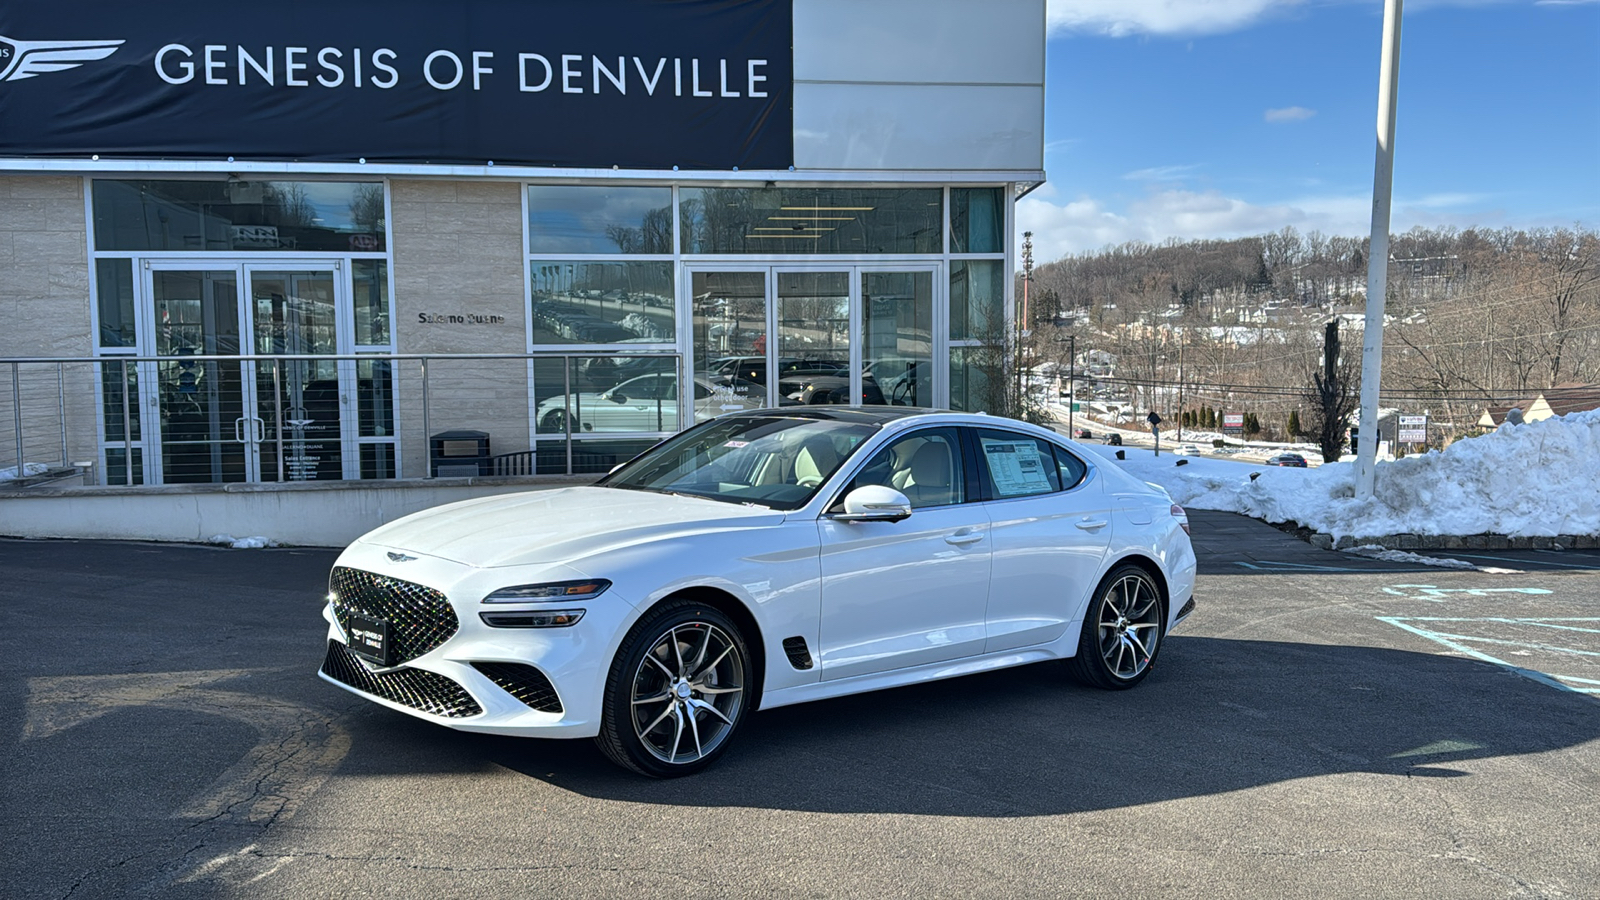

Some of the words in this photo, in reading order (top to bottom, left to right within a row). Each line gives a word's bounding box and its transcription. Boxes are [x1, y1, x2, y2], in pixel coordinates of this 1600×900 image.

[154, 43, 399, 89] GENESIS
[423, 49, 494, 90] OF
[518, 52, 768, 98] DENVILLE
